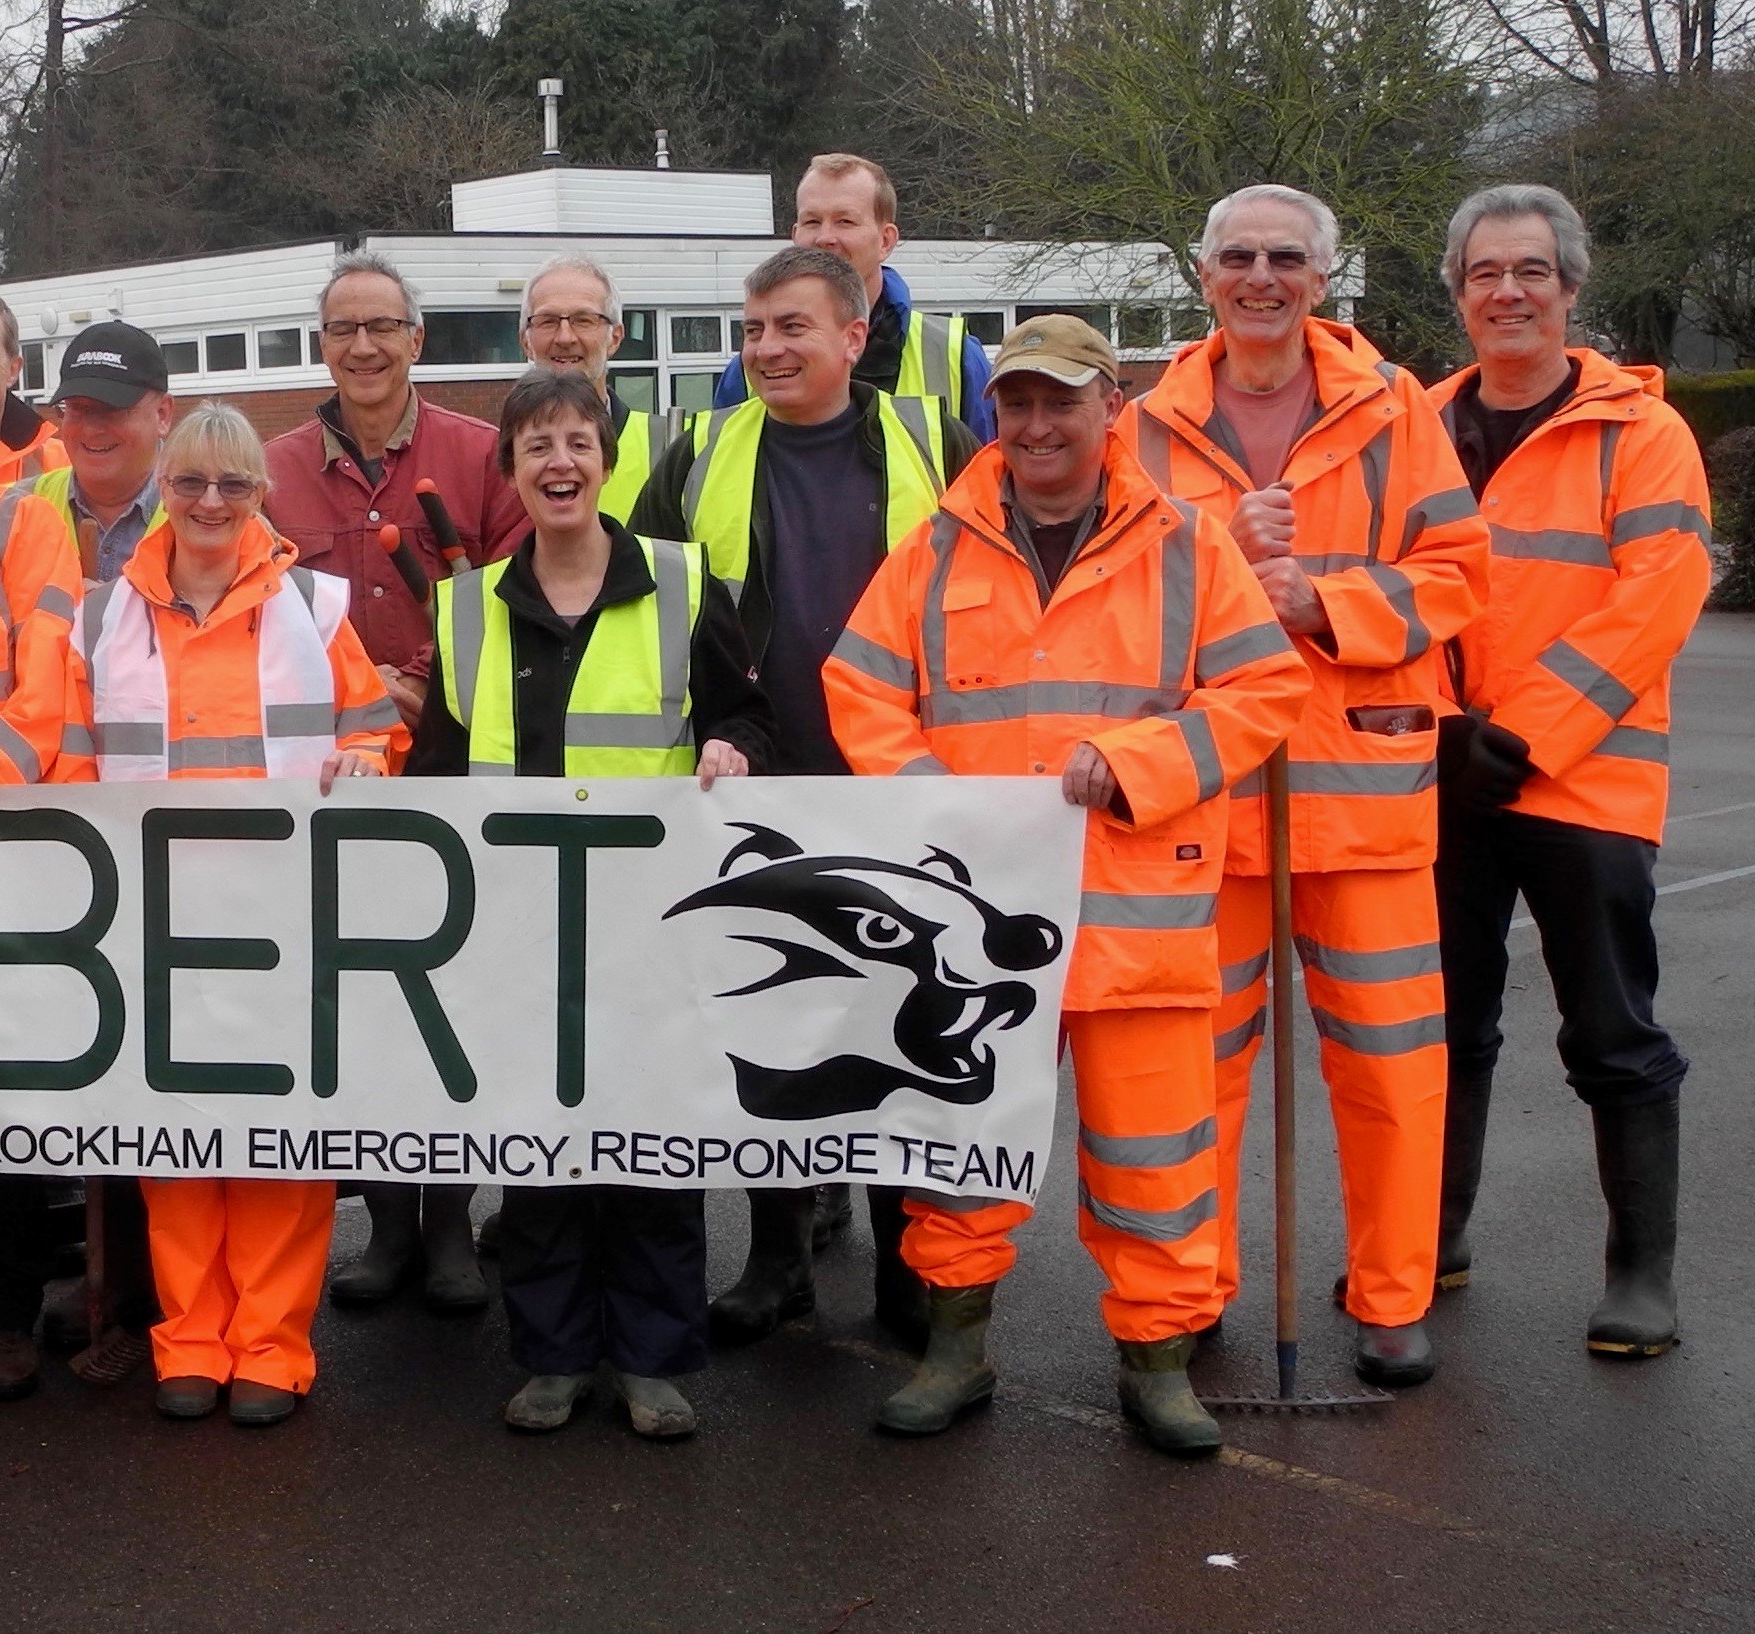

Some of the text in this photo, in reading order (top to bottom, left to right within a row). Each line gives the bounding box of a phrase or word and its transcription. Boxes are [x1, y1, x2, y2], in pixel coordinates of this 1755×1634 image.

[248, 1127, 570, 1177] EMERGENCY
[591, 1131, 878, 1179] RESPONSE
[889, 1134, 1034, 1194] TEAM
